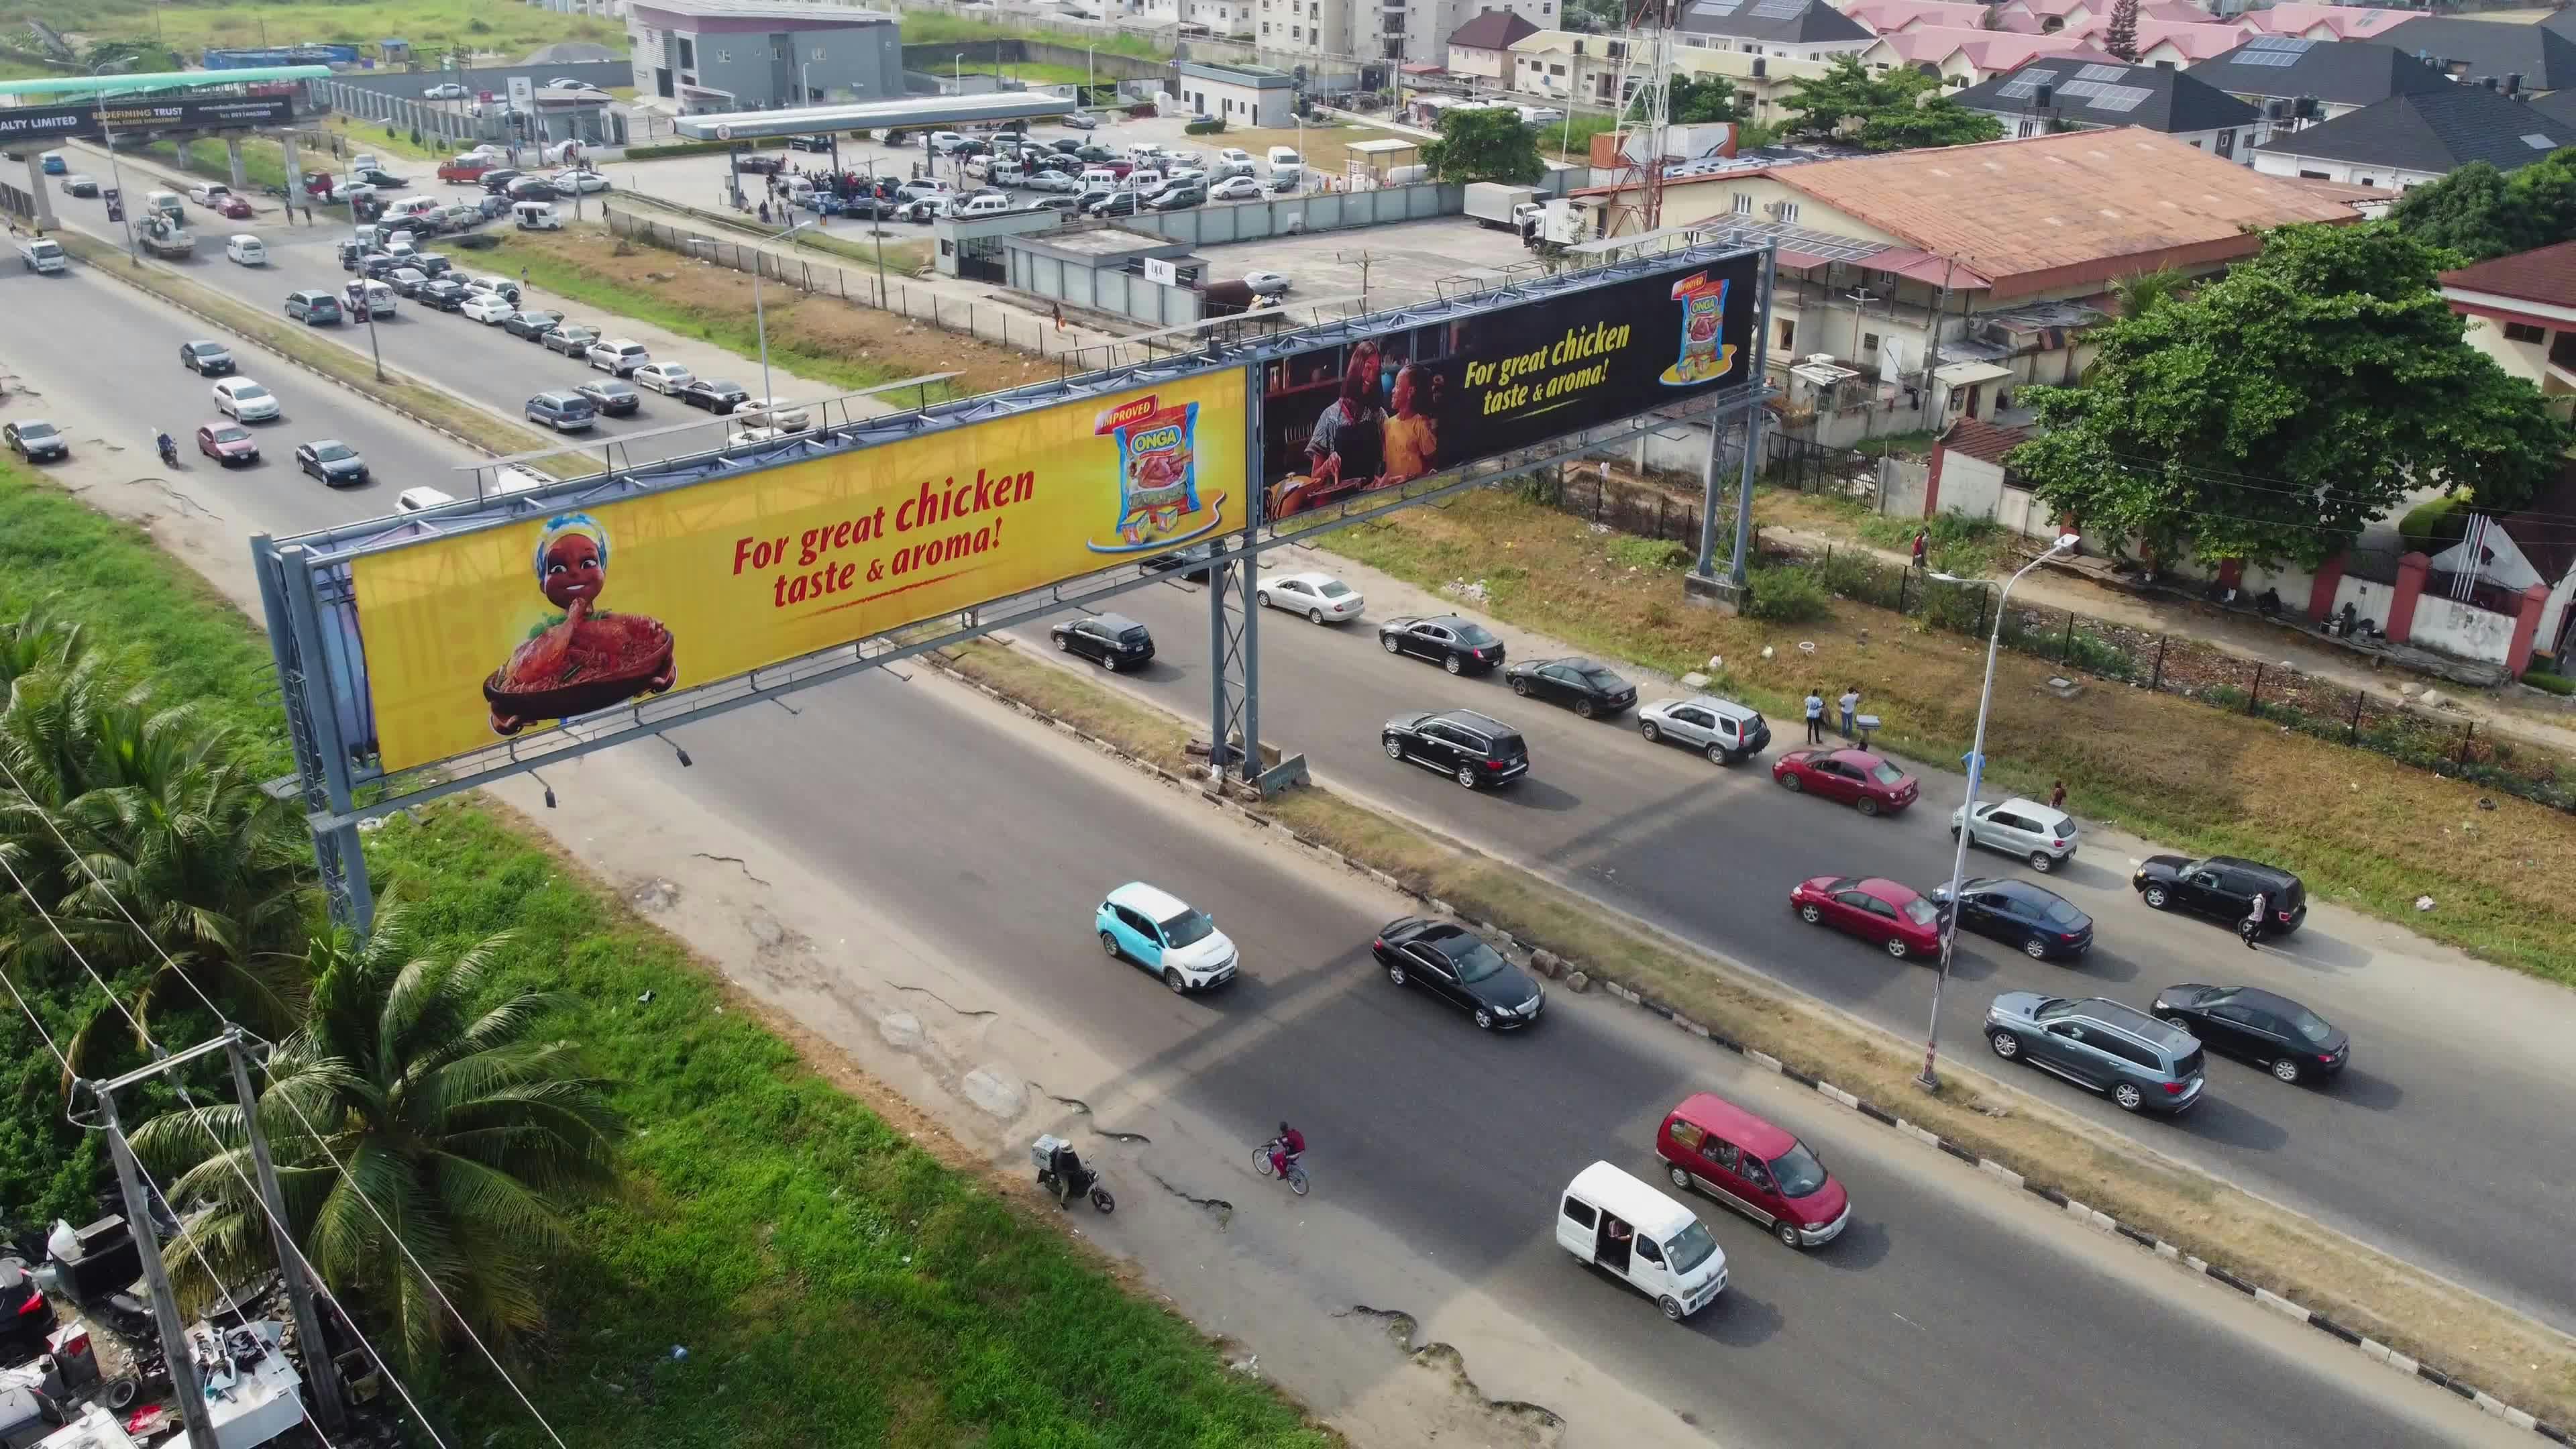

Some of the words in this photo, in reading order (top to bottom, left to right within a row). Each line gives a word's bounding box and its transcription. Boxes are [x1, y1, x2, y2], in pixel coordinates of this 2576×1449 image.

[0, 119, 27, 130] ALTY
[31, 115, 77, 128] LIMITED
[154, 107, 183, 116] TRUST
[1692, 299, 1715, 313] ONGA
[1464, 361, 1497, 389] For
[1498, 344, 1548, 386] great
[1551, 321, 1630, 366] chicken
[1482, 383, 1529, 415] taste
[1532, 383, 1544, 401] &
[1546, 358, 1609, 398] aroma!
[1101, 402, 1150, 427] IMPROVED
[1134, 429, 1177, 451] ONGA
[733, 536, 789, 576] For
[798, 506, 885, 566] great
[896, 468, 1034, 532] chicken
[774, 561, 855, 608] taste
[866, 558, 884, 582] &
[892, 516, 1003, 576] aroma!
